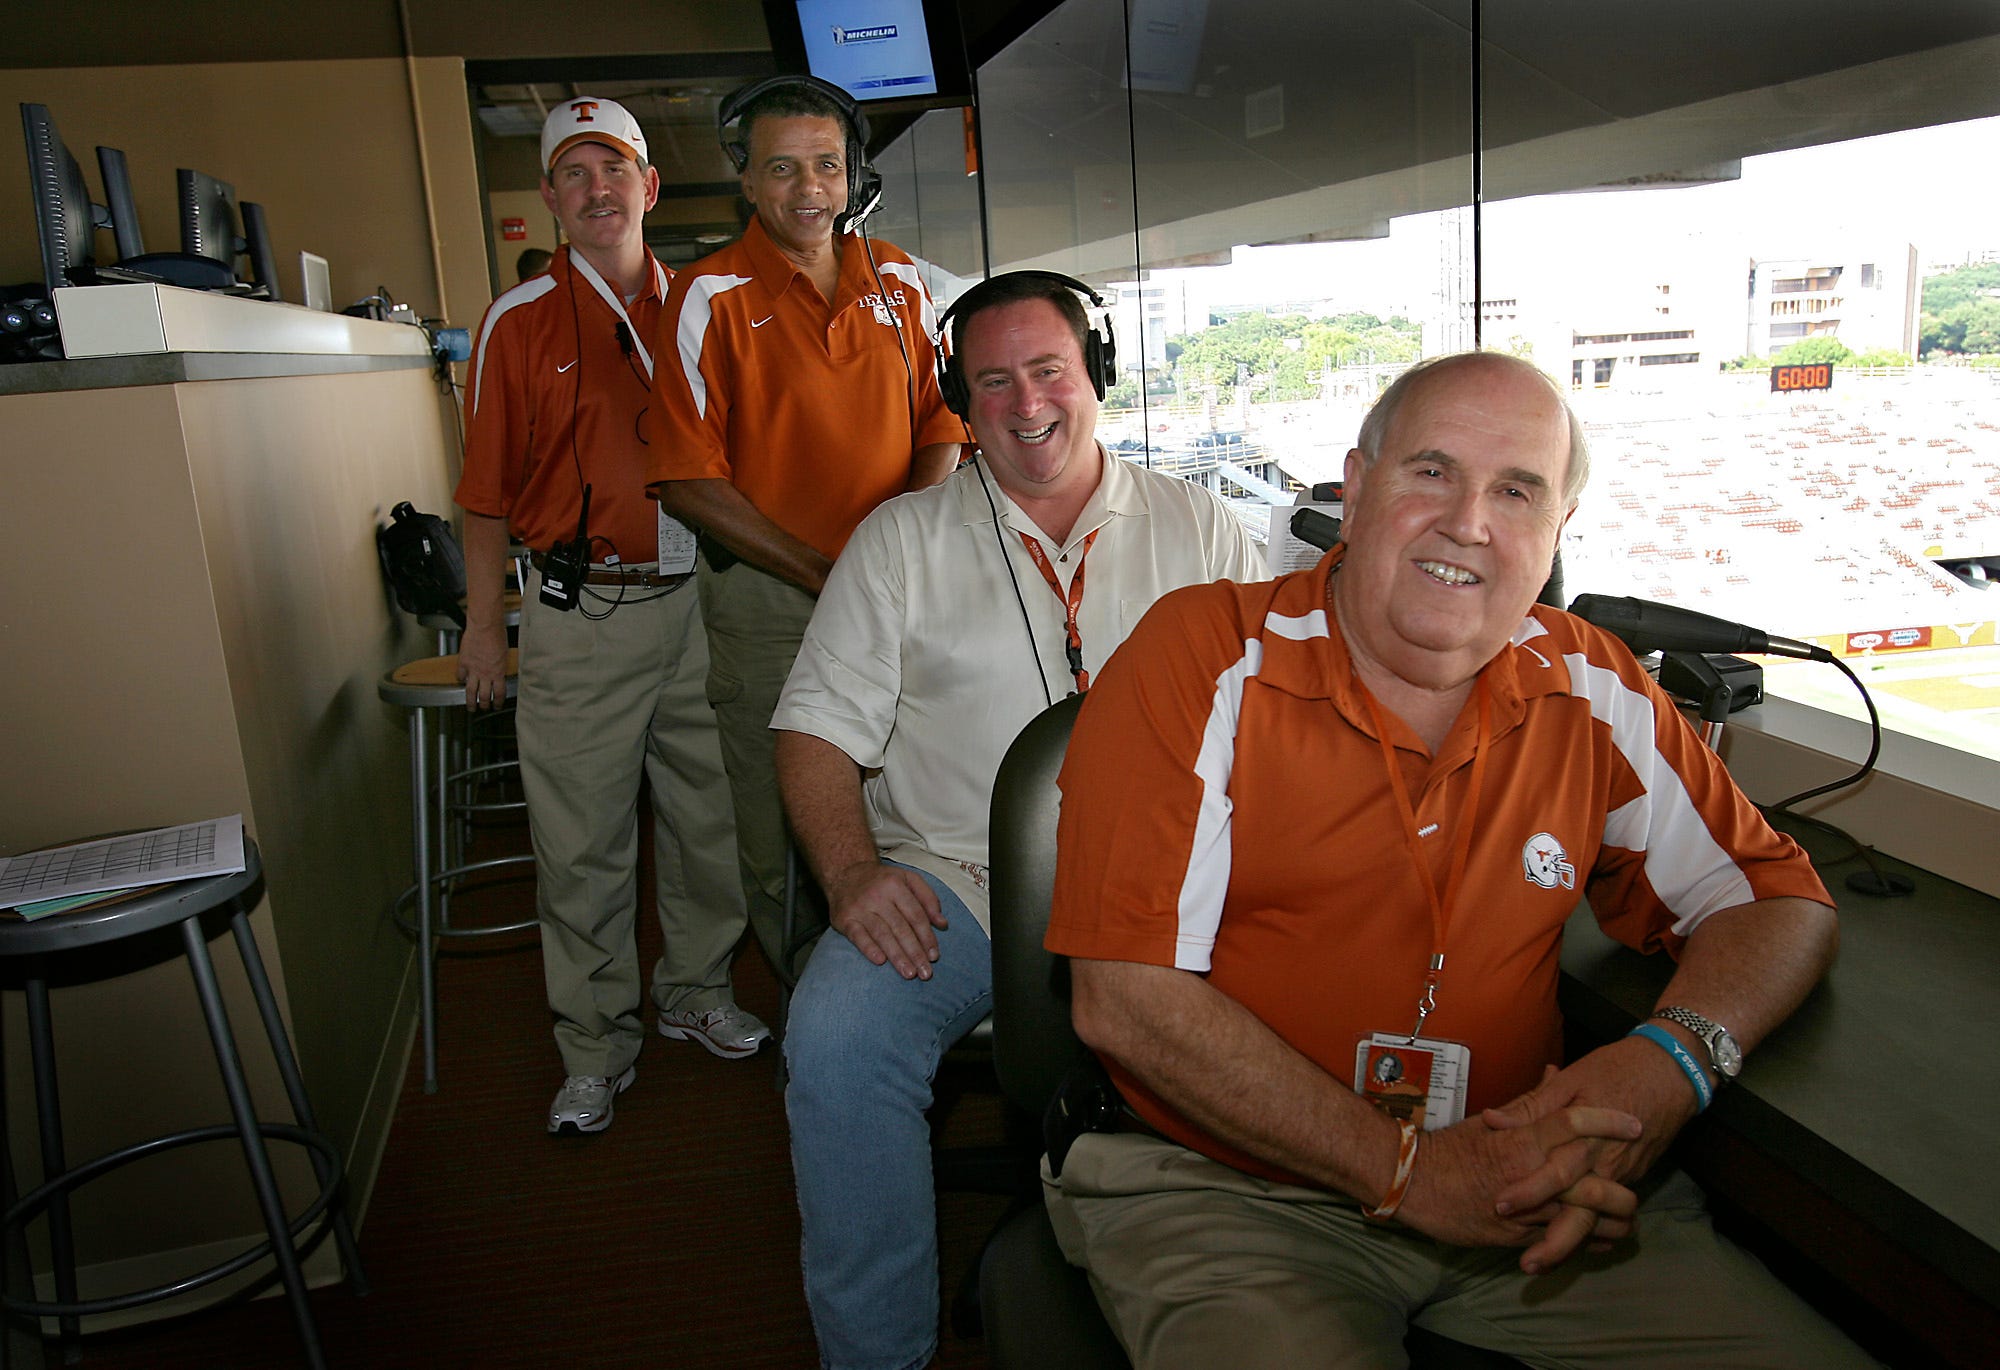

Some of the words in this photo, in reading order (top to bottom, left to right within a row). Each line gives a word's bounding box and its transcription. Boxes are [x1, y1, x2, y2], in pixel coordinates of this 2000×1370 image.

[846, 27, 896, 40] MICHELIN
[570, 101, 599, 123] T
[858, 290, 907, 308] TEXAS
[1777, 365, 1828, 390] 60:00
